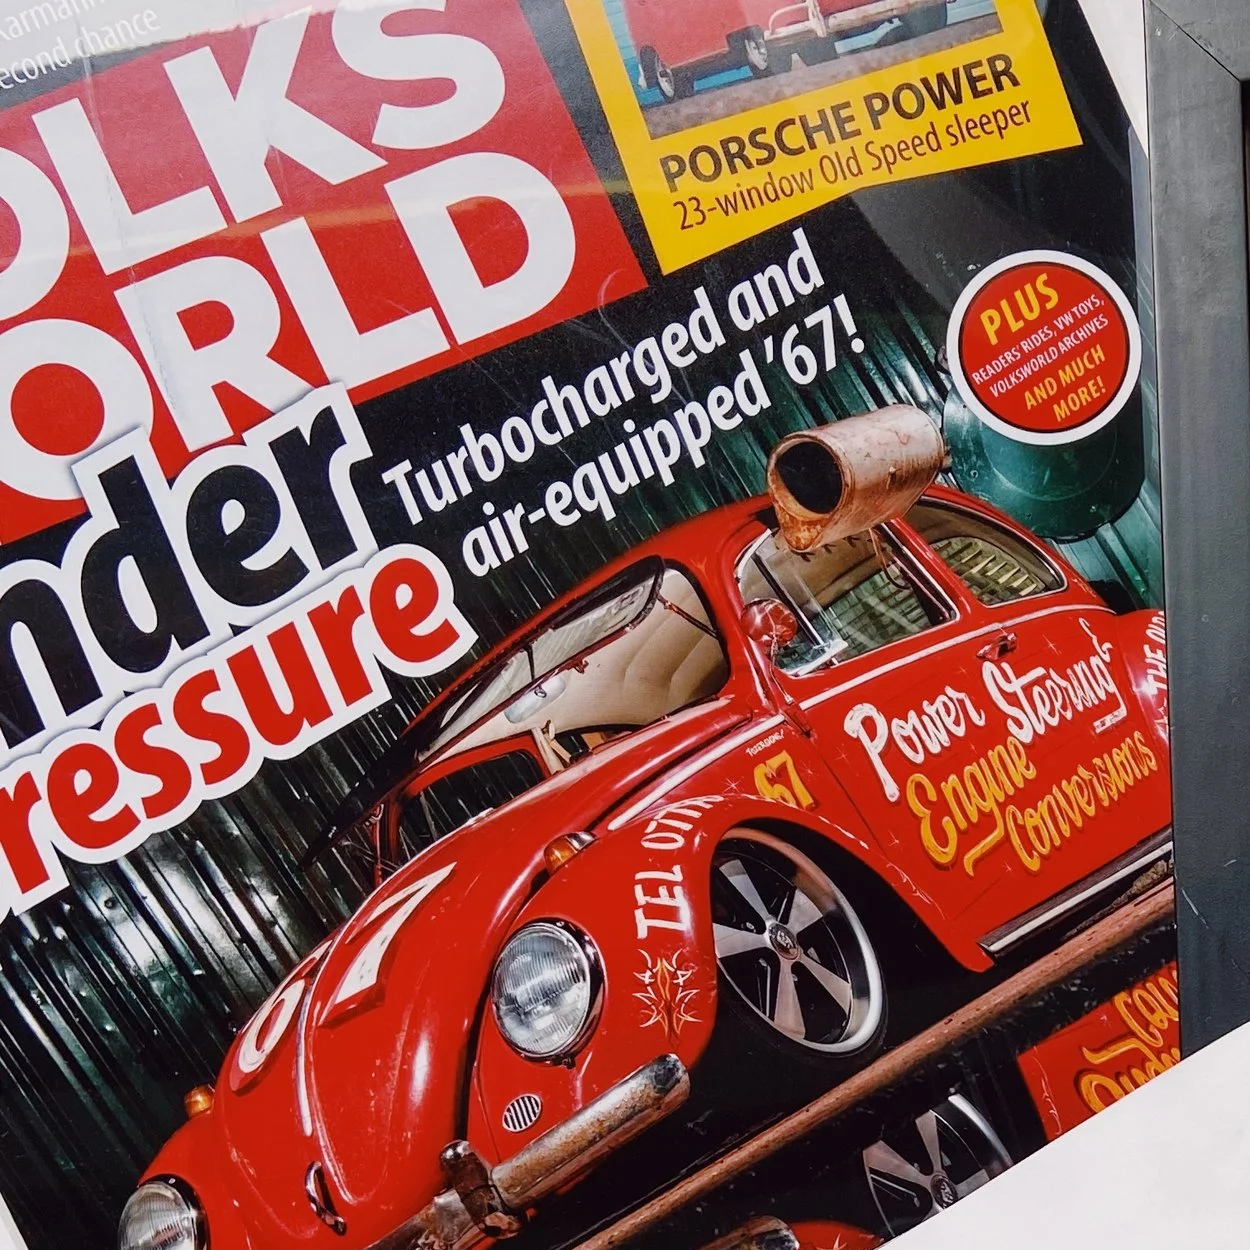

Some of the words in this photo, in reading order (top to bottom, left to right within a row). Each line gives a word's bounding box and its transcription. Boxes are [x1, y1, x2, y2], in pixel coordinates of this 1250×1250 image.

[0, 0, 97, 41] arman
[74, 9, 161, 58] chance
[659, 101, 862, 193] PORSCHE
[863, 54, 1021, 130] POWER
[673, 167, 814, 230] 23-window
[819, 146, 863, 185] Old
[865, 122, 942, 174] Speed
[945, 100, 1033, 147] sleeper
[980, 273, 1058, 345] PLUS
[1020, 326, 1057, 353] RIDES,
[1053, 313, 1074, 331] VW
[1072, 294, 1105, 319] TOYS,
[382, 286, 727, 526] Turbocharged
[727, 227, 824, 332] and
[989, 347, 1058, 398] VOLKSWORLD
[1056, 314, 1109, 354] ARCHIVES
[1024, 377, 1057, 410] AND
[1058, 344, 1106, 387] MUCH
[1053, 376, 1107, 422] MORE!
[462, 349, 772, 577] air-equipped
[0, 557, 460, 894] ressure
[844, 686, 985, 802] Power
[982, 617, 1128, 743] Steering
[754, 750, 818, 810] 67
[906, 735, 1037, 876] Engine
[1005, 731, 1158, 872] Conversions
[634, 864, 690, 940] TEL
